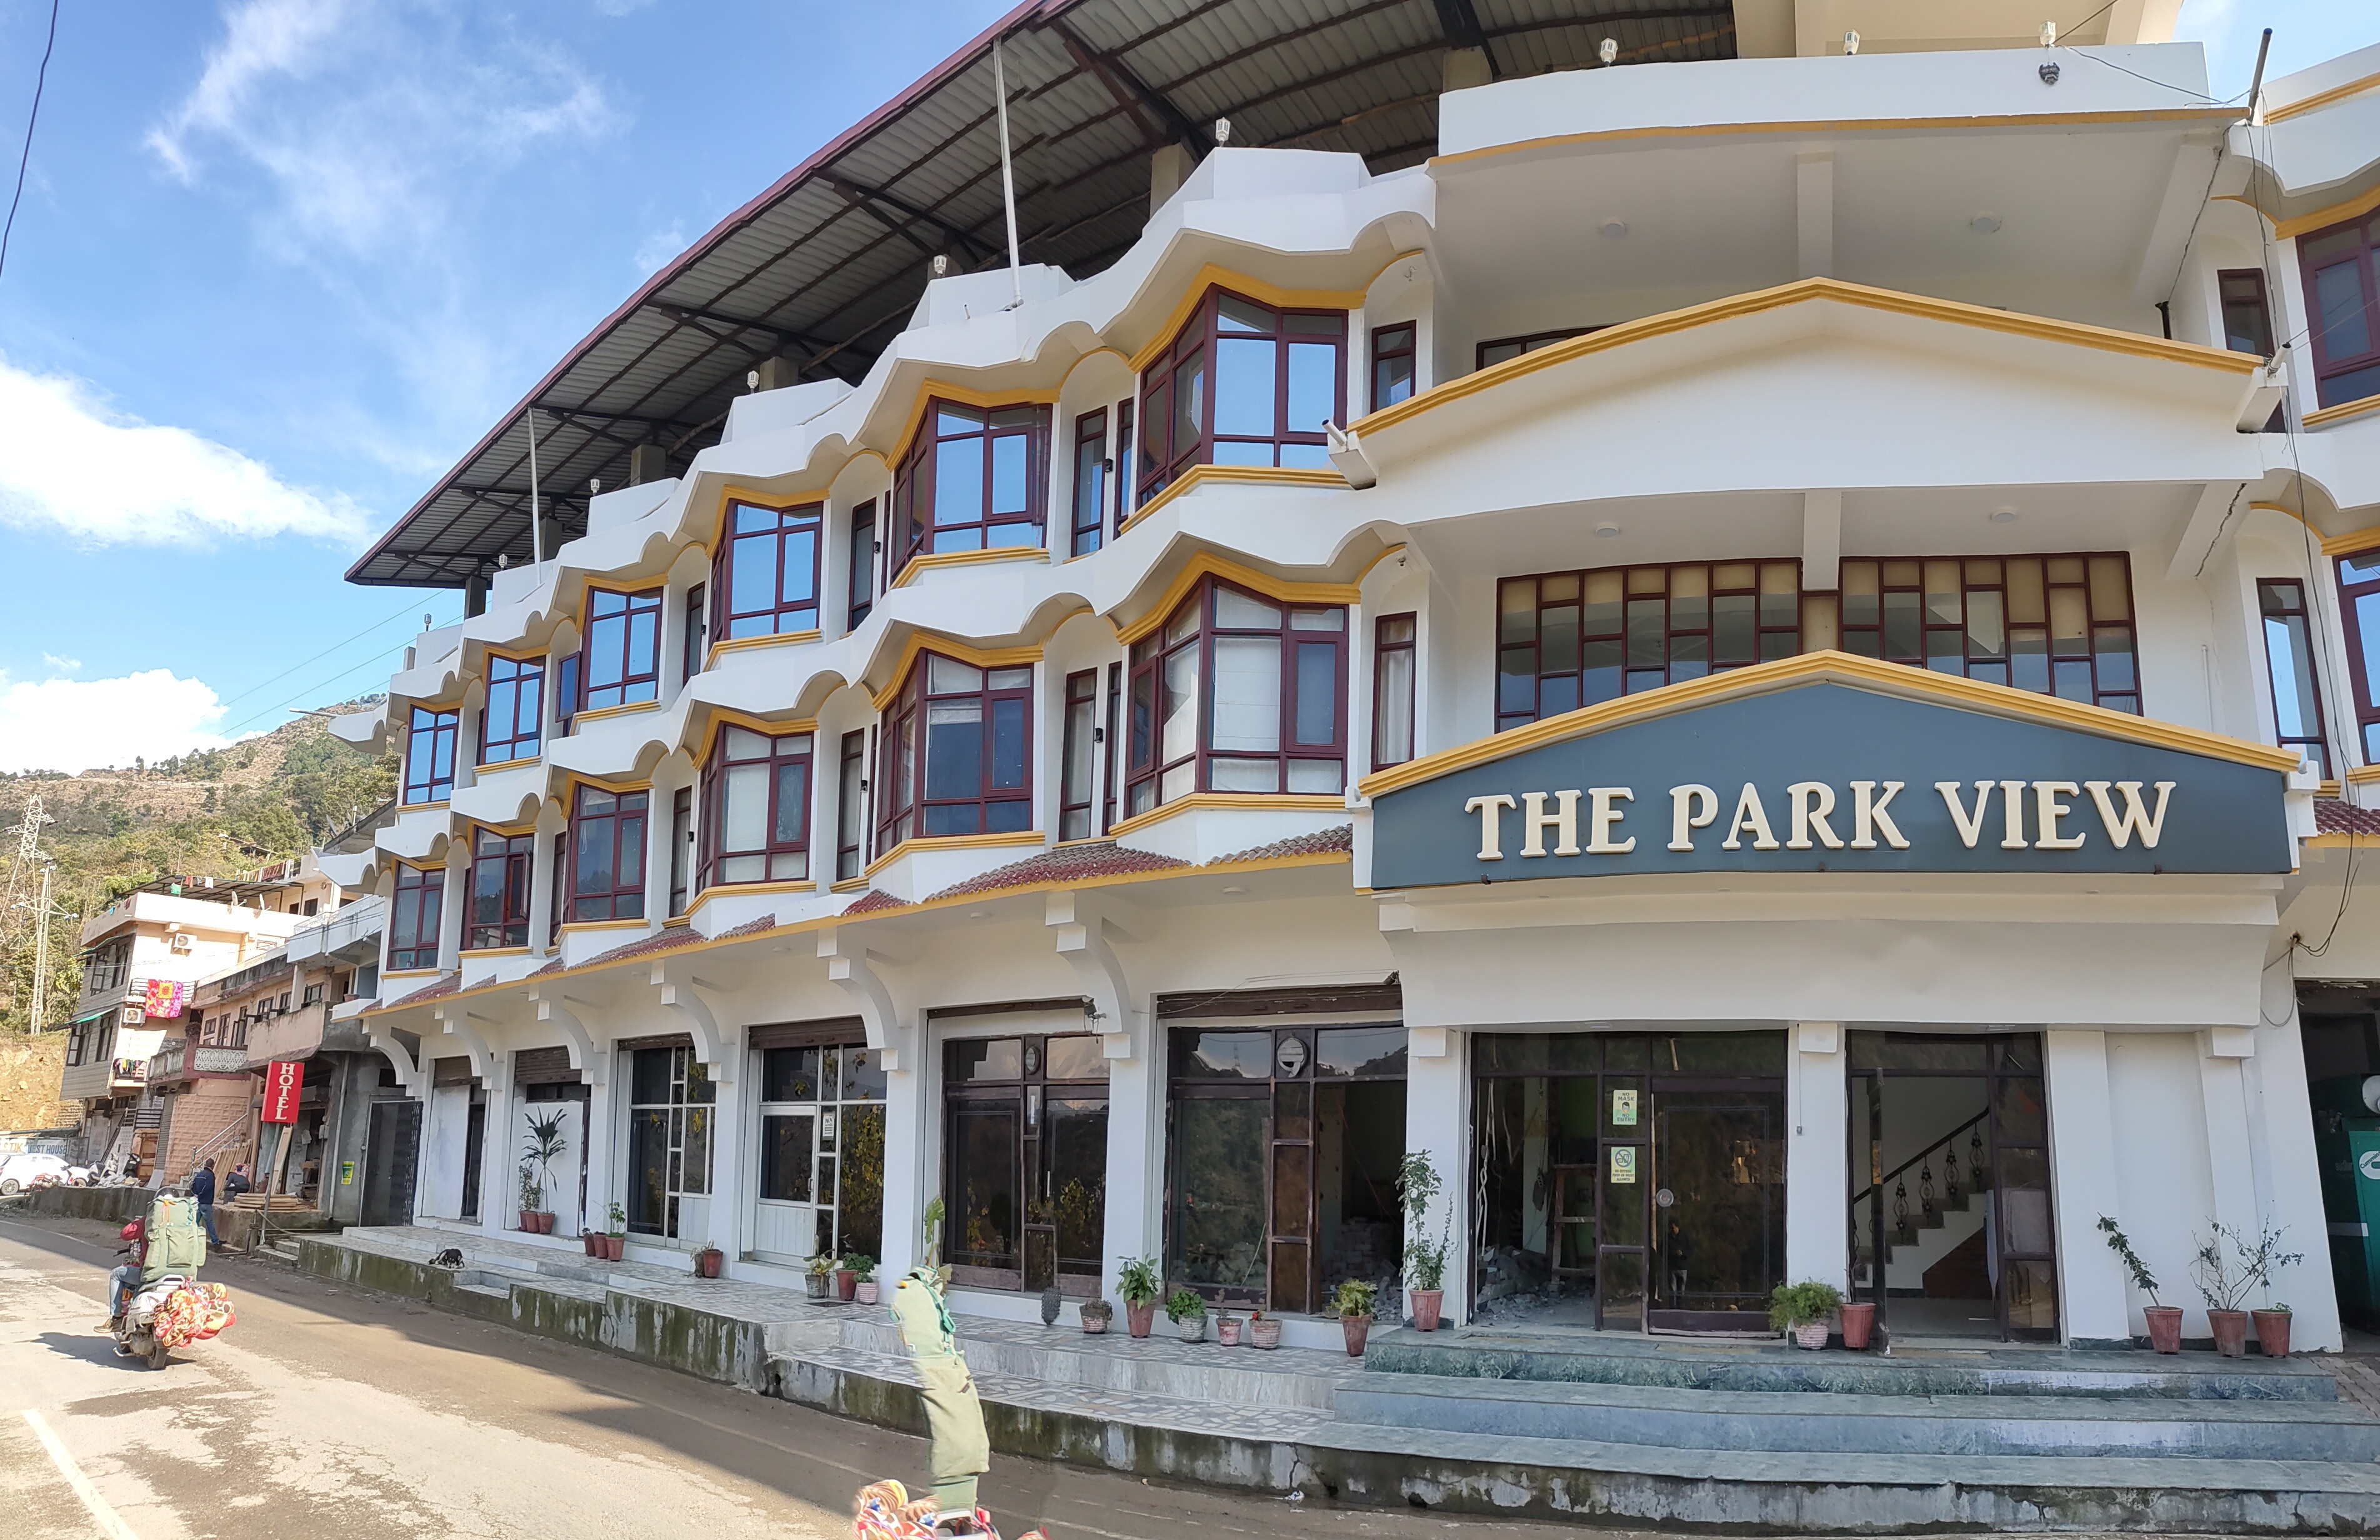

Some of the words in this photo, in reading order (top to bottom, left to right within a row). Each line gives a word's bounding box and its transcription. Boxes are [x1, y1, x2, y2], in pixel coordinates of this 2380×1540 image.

[1465, 787, 1637, 860] THE
[1668, 781, 1911, 850] PARK
[1935, 781, 2176, 849] VIEW
[275, 1063, 295, 1120] HOTEL
[46, 1144, 67, 1154] HOUSE
